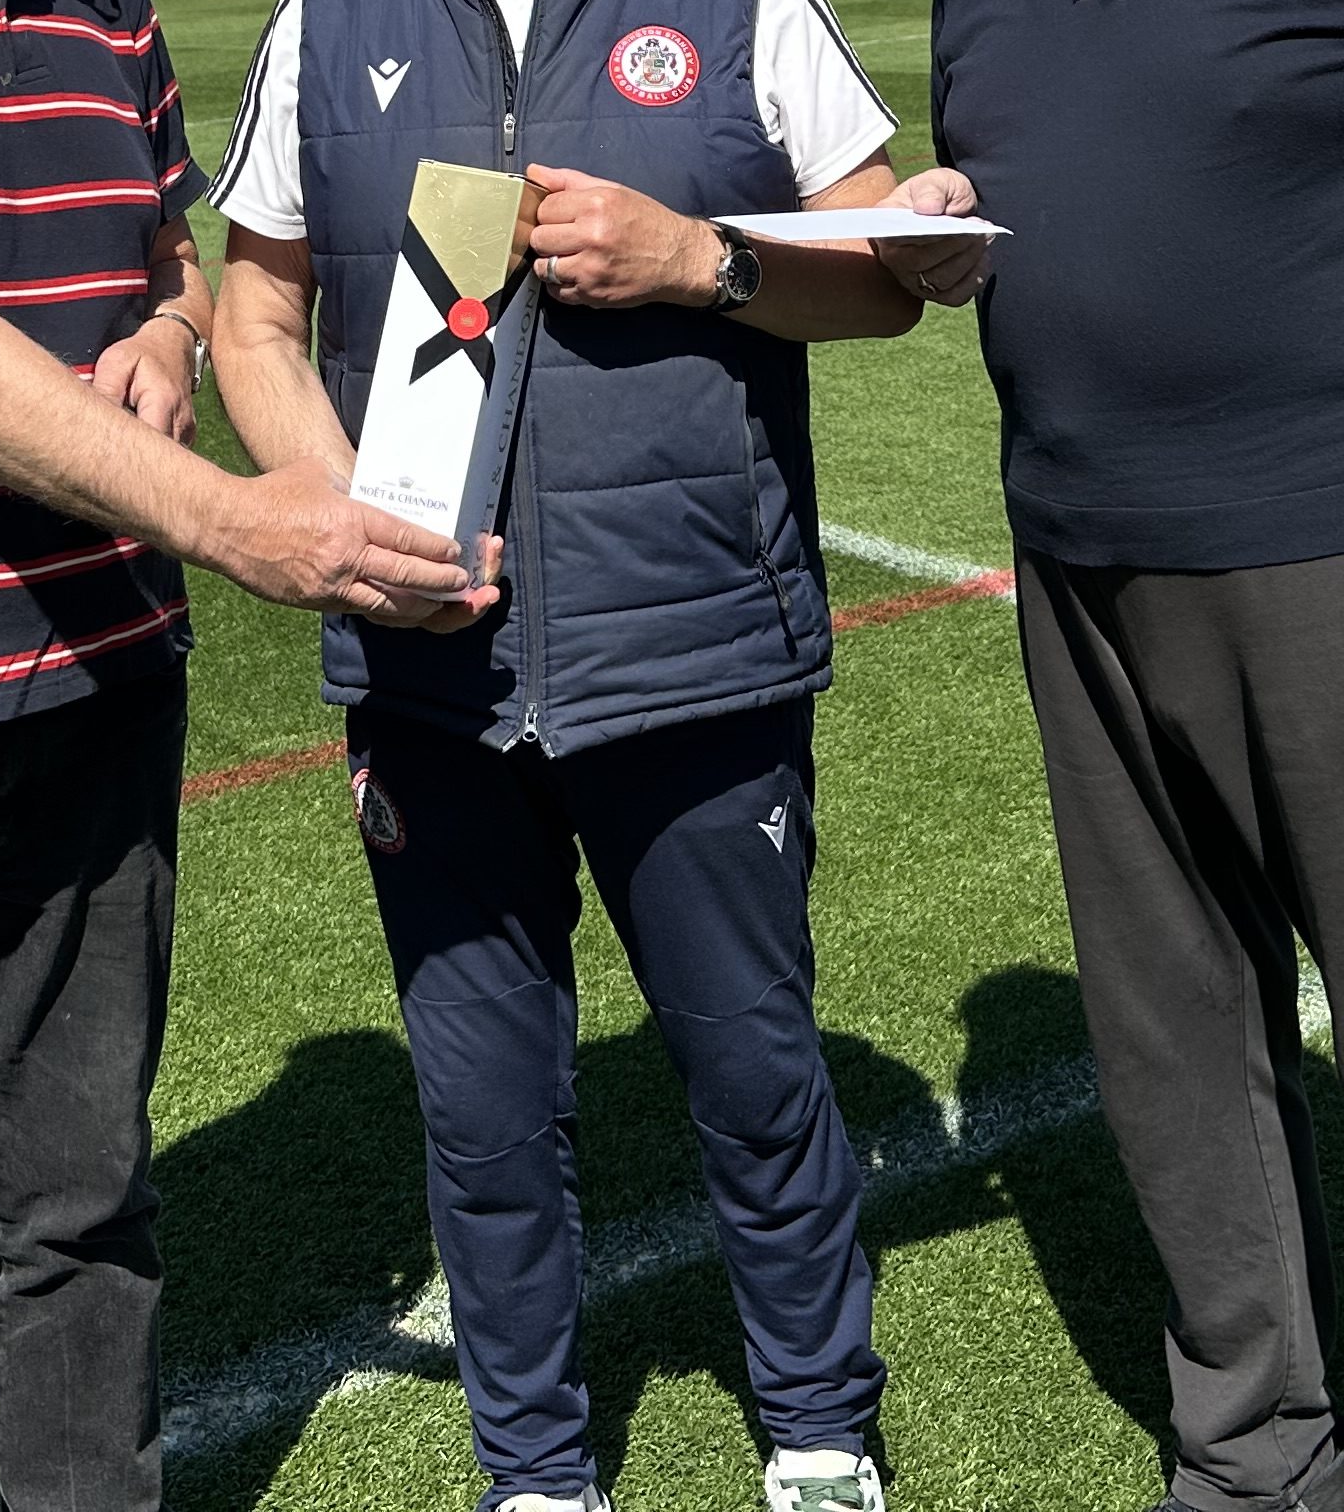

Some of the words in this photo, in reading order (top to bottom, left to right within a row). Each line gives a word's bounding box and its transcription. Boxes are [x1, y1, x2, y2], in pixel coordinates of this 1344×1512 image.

[498, 289, 536, 453] CHANDON
[359, 485, 386, 500] MOËT
[387, 492, 395, 501] &
[398, 494, 449, 512] CHANDON
